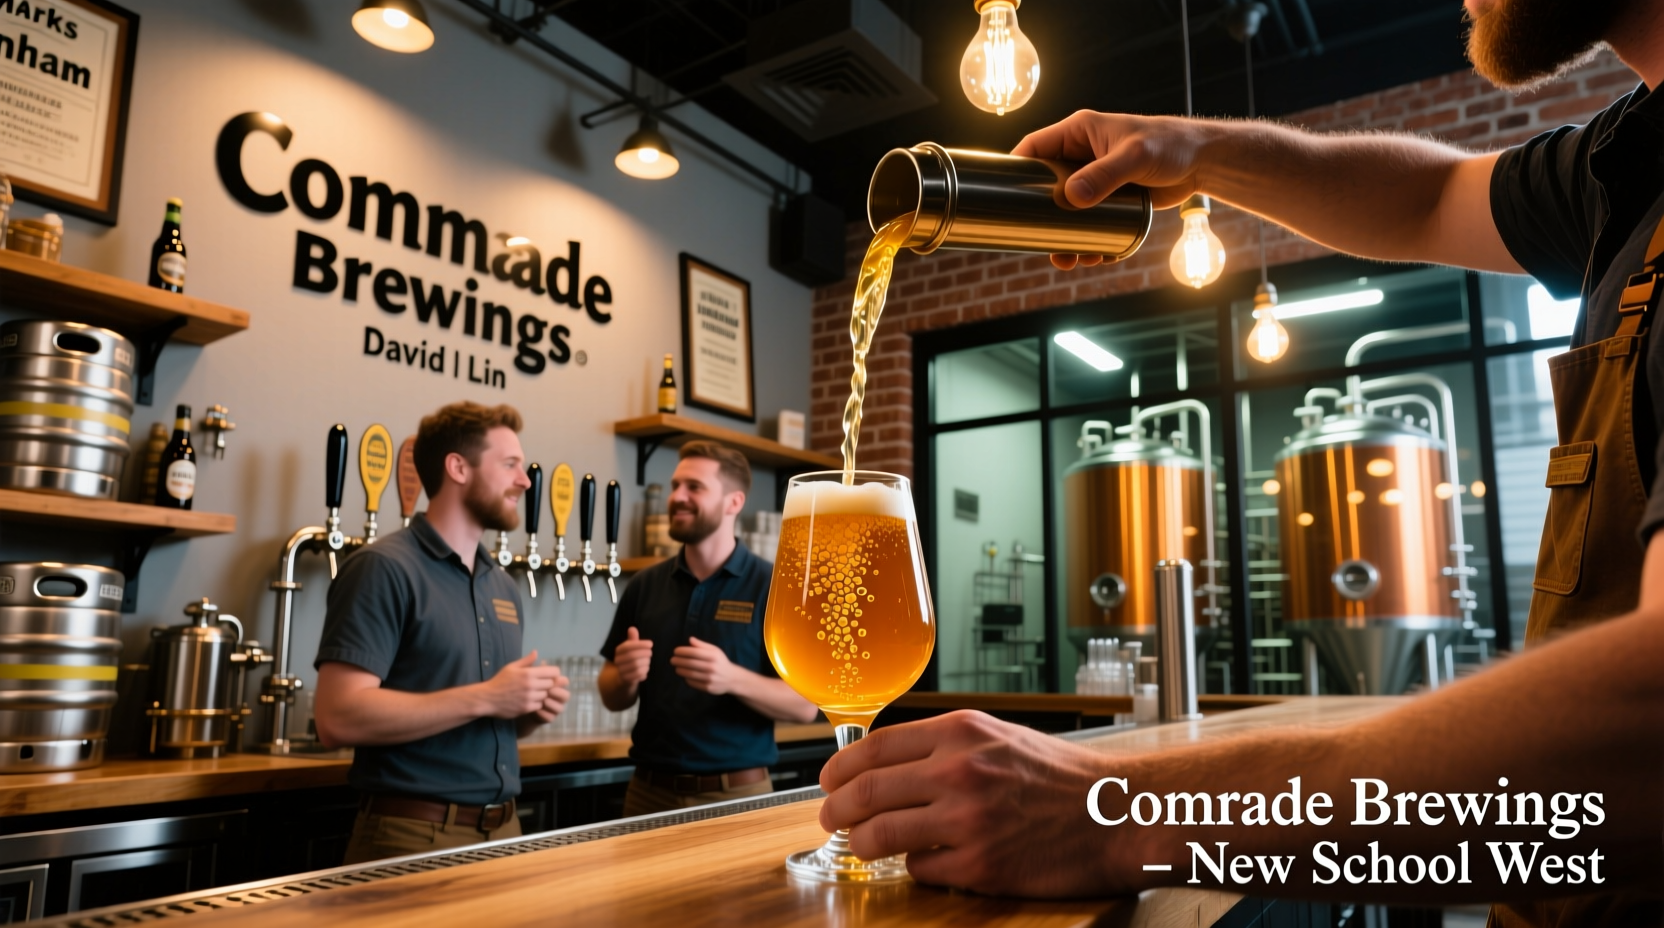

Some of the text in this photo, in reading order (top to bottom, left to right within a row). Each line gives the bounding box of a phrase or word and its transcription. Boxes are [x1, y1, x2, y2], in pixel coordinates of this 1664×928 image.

[292, 229, 572, 376] Brewings
[363, 326, 446, 374] David
[468, 355, 506, 390] Lin
